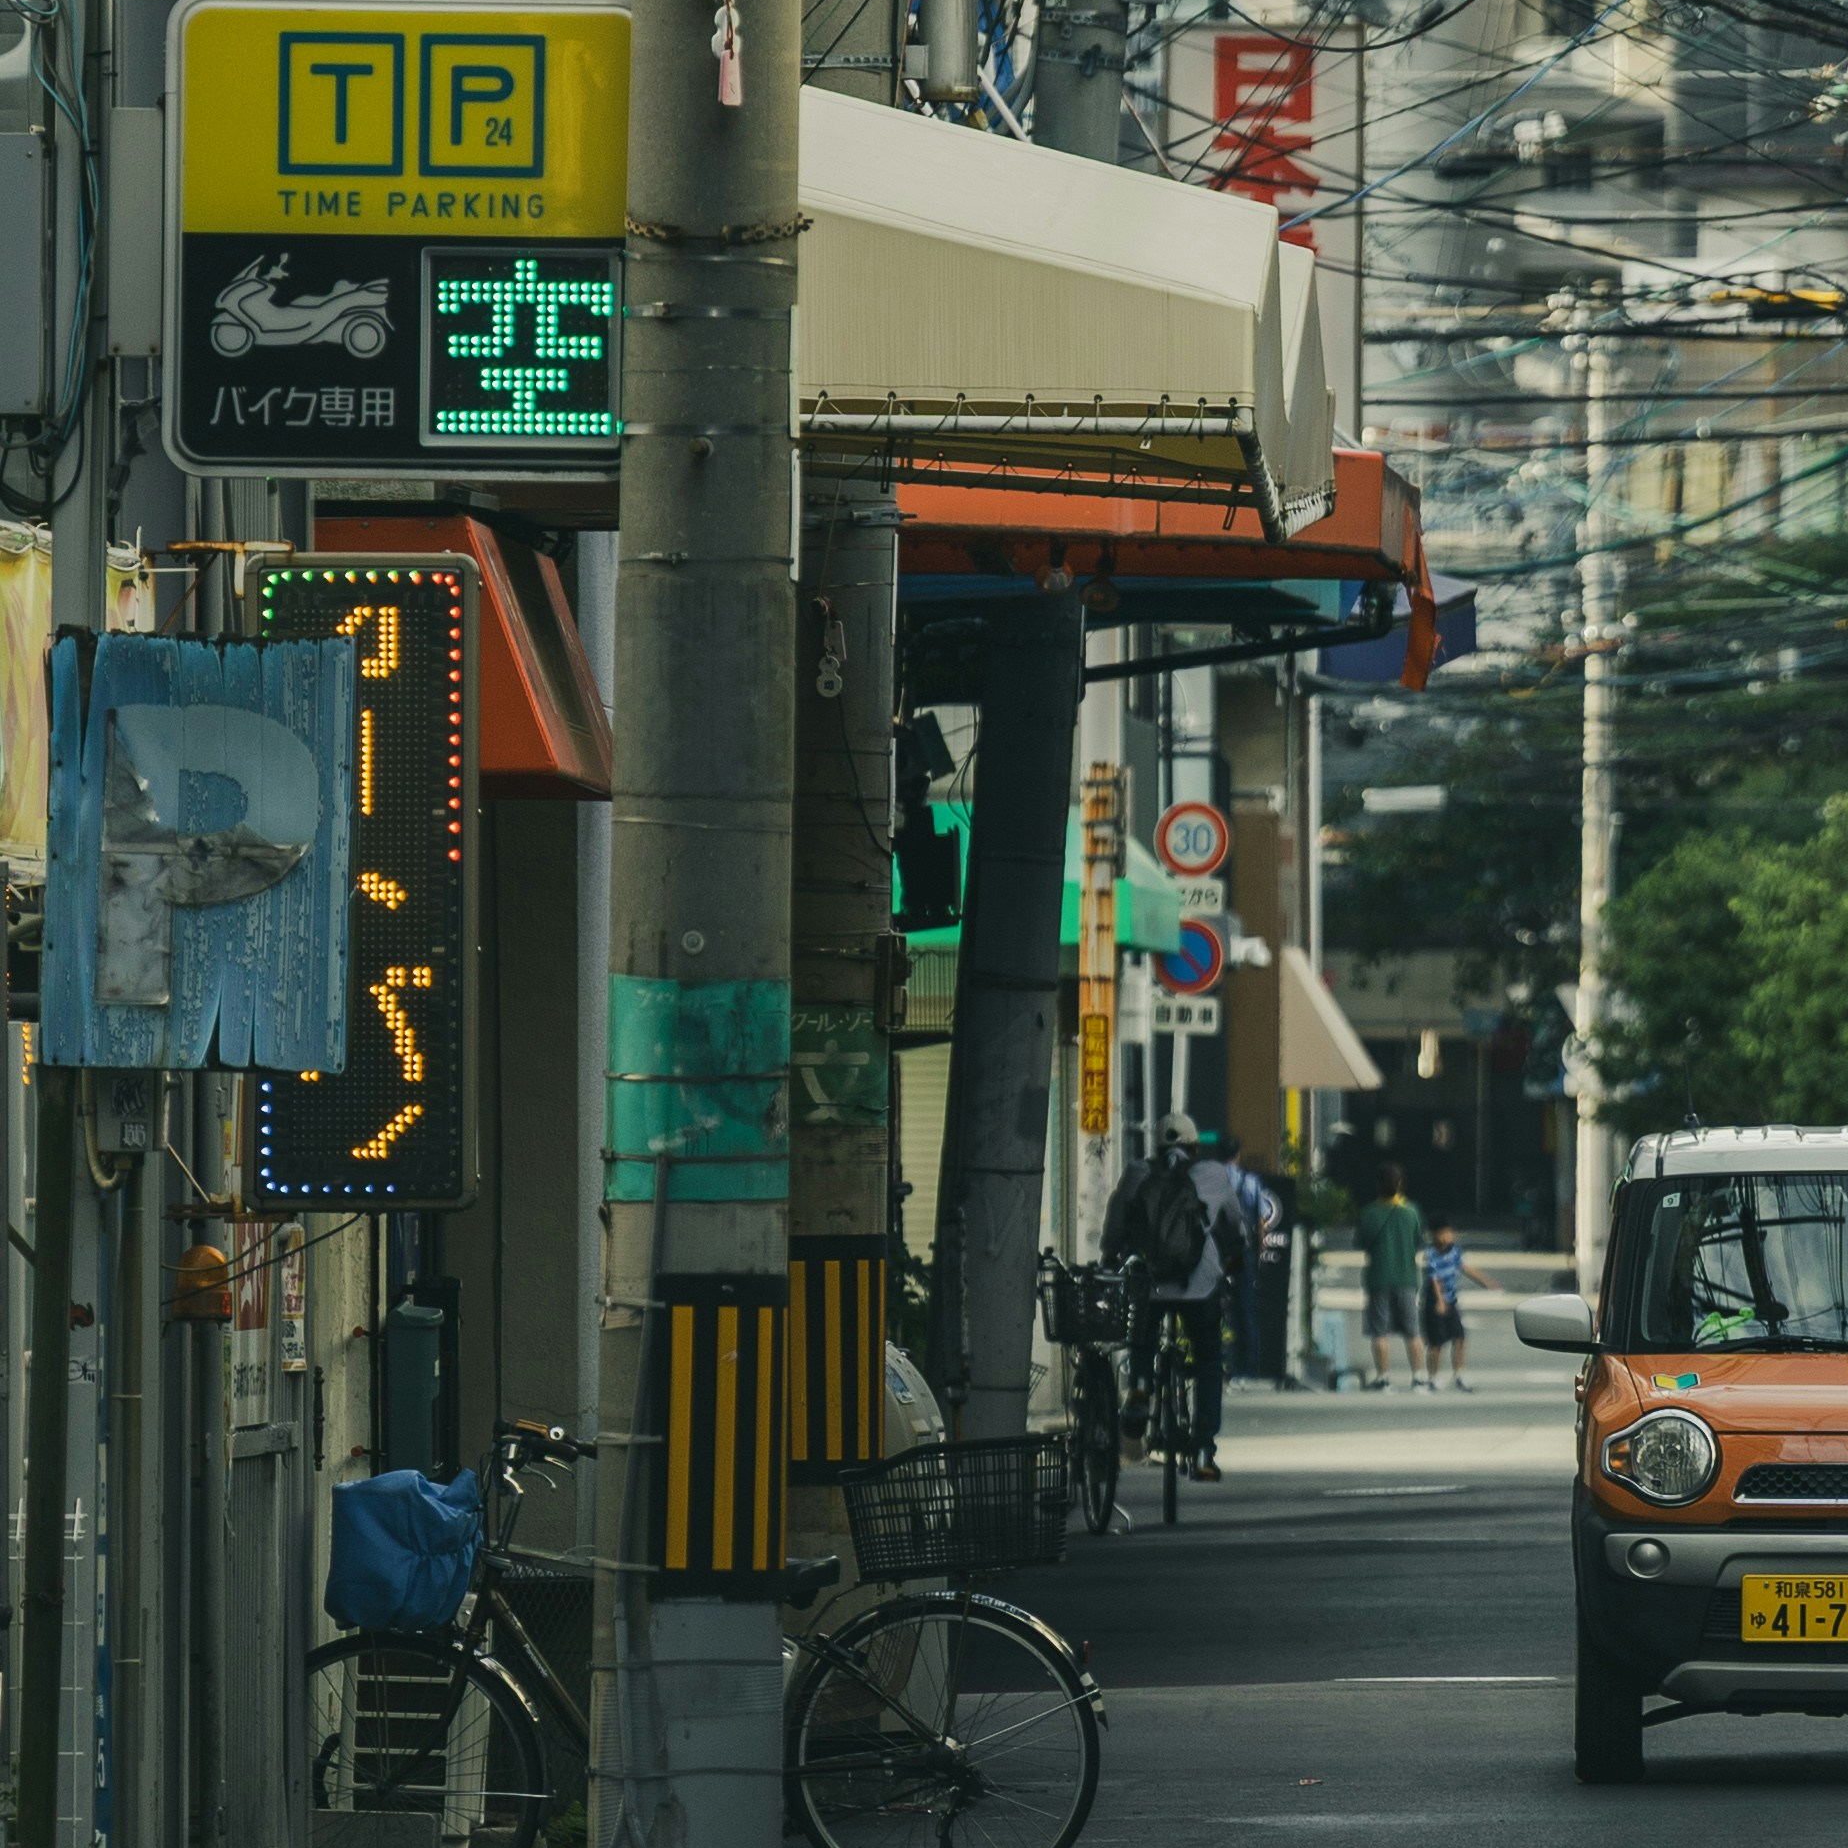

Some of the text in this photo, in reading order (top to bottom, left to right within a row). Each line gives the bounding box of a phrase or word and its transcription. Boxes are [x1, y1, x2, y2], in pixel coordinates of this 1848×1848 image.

[485, 117, 513, 146] 24
[1211, 36, 1322, 257] 日本
[278, 190, 546, 219] TIME PARKING
[436, 258, 614, 435] 空
[210, 386, 395, 428] バイク専用
[1172, 822, 1214, 857] 30
